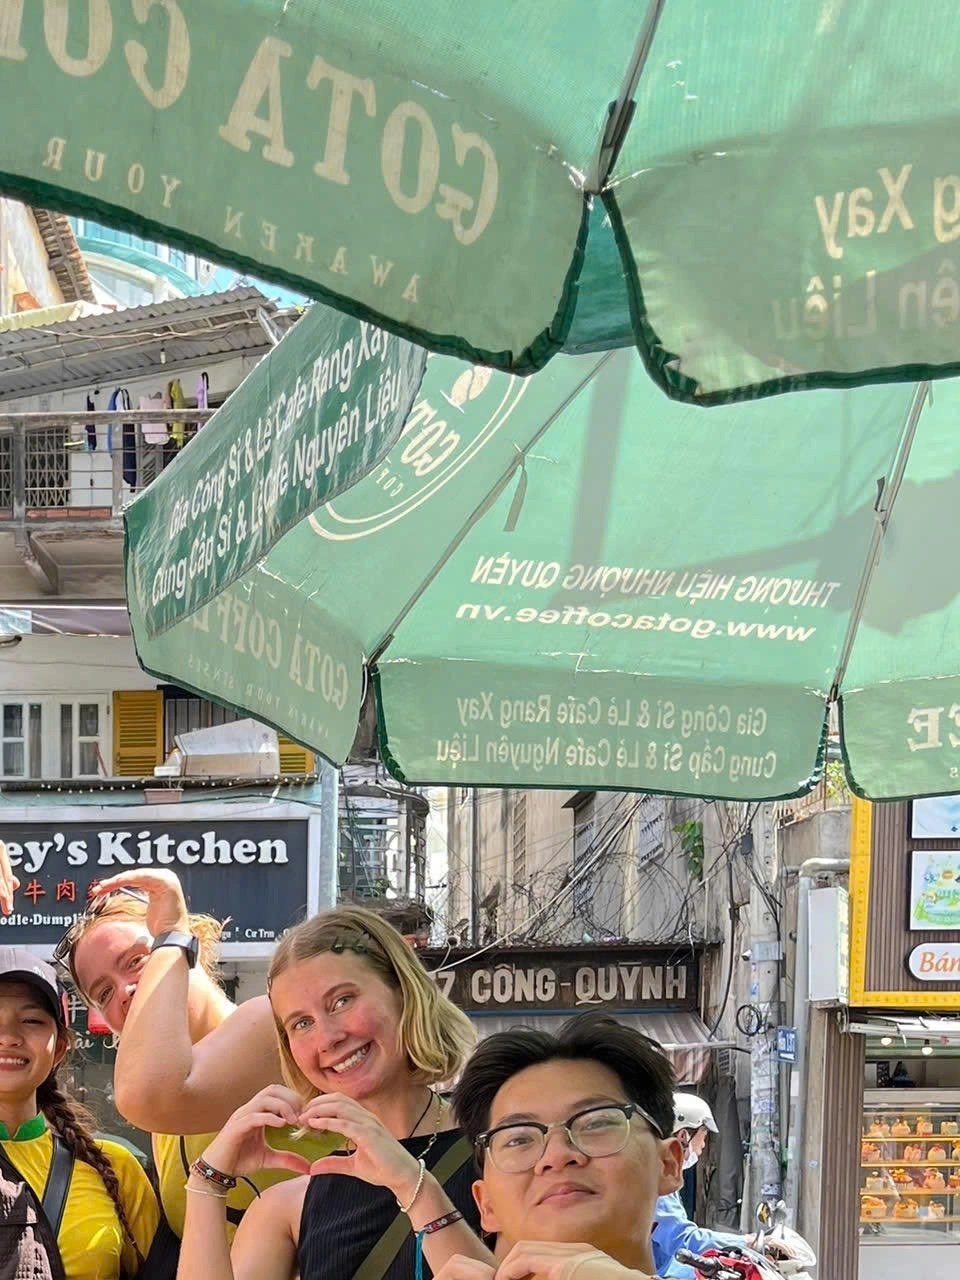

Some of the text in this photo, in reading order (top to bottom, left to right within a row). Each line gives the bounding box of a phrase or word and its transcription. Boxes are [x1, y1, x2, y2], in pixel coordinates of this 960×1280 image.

[308, 338, 354, 409] Rang
[293, 401, 360, 489] Nguyên
[365, 368, 402, 433] Liệu
[97, 831, 289, 865] Kitchen
